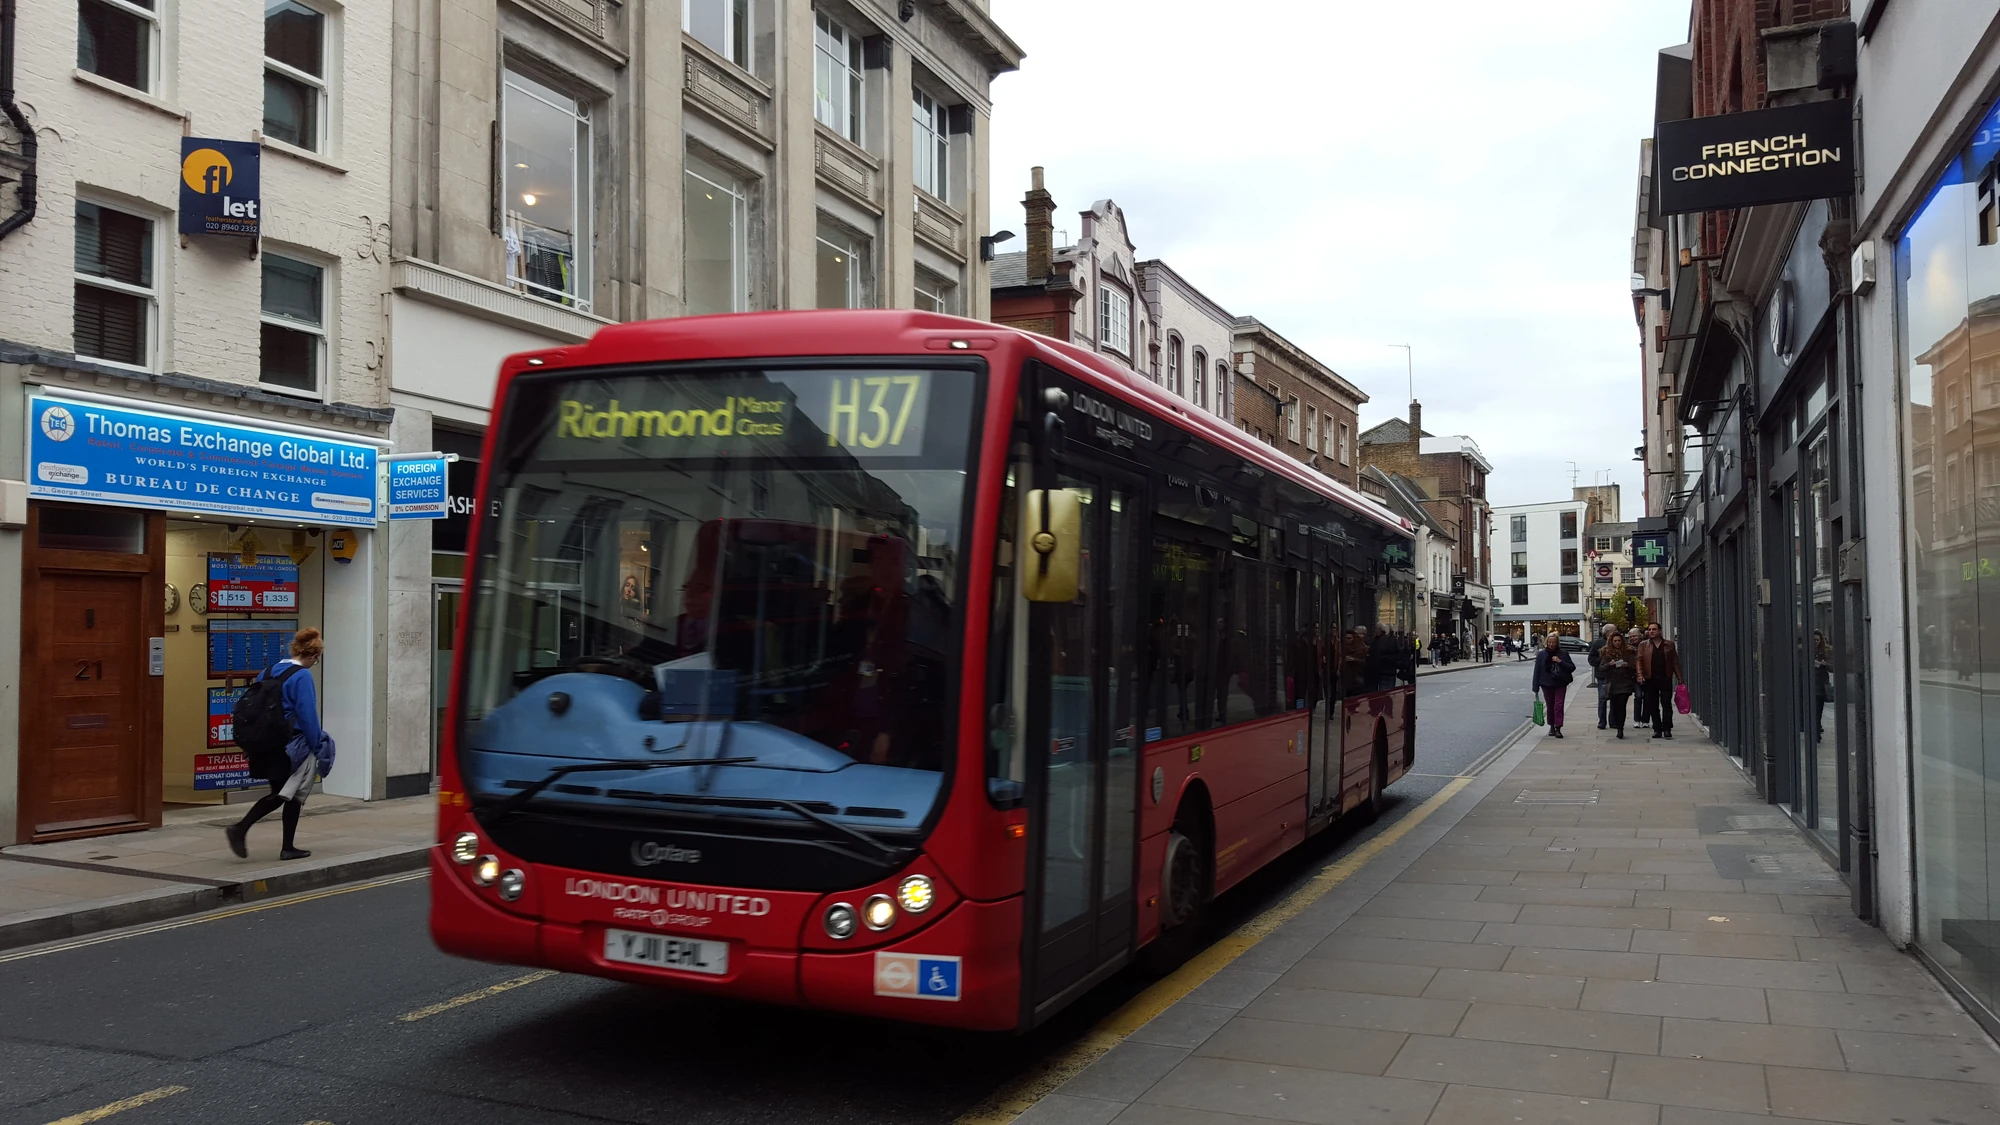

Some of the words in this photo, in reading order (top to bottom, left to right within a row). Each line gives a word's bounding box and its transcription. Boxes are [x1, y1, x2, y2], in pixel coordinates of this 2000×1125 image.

[1702, 133, 1807, 160] FRENCH
[1672, 147, 1841, 182] CONNECTION
[223, 196, 257, 219] let
[205, 222, 219, 230] 020
[221, 223, 239, 231] 8940
[241, 224, 257, 233] 2332
[557, 396, 736, 438] Richmond
[827, 375, 921, 449] H37
[1072, 390, 1116, 425] LONDON
[1116, 410, 1153, 441] UNITED
[50, 416, 66, 430] TEG
[85, 413, 171, 443] Thomas
[180, 426, 273, 459] Exchange
[279, 441, 334, 465] Global
[340, 450, 370, 470] Ltd.
[129, 443, 184, 457] Corporate
[135, 456, 197, 472] WORLD'S
[202, 464, 258, 478] FOREIGN
[263, 472, 327, 487] EXCHANGE
[397, 463, 437, 474] FOREIGN
[105, 472, 188, 492] BUREAU
[195, 482, 220, 495] DE
[227, 486, 300, 503] CHANGE
[393, 475, 442, 487] EXCHANGE
[51, 487, 78, 496] George
[80, 489, 102, 498] Street
[395, 488, 439, 499] SERVICES
[405, 504, 439, 512] COMMISION
[333, 540, 344, 548] ADT
[264, 594, 289, 602] 1.335
[74, 659, 103, 681] 21
[207, 754, 246, 764] TRAVEL
[195, 772, 242, 780] INTERNATIONAL
[565, 877, 660, 905] LONDON
[666, 888, 771, 916] UNITED
